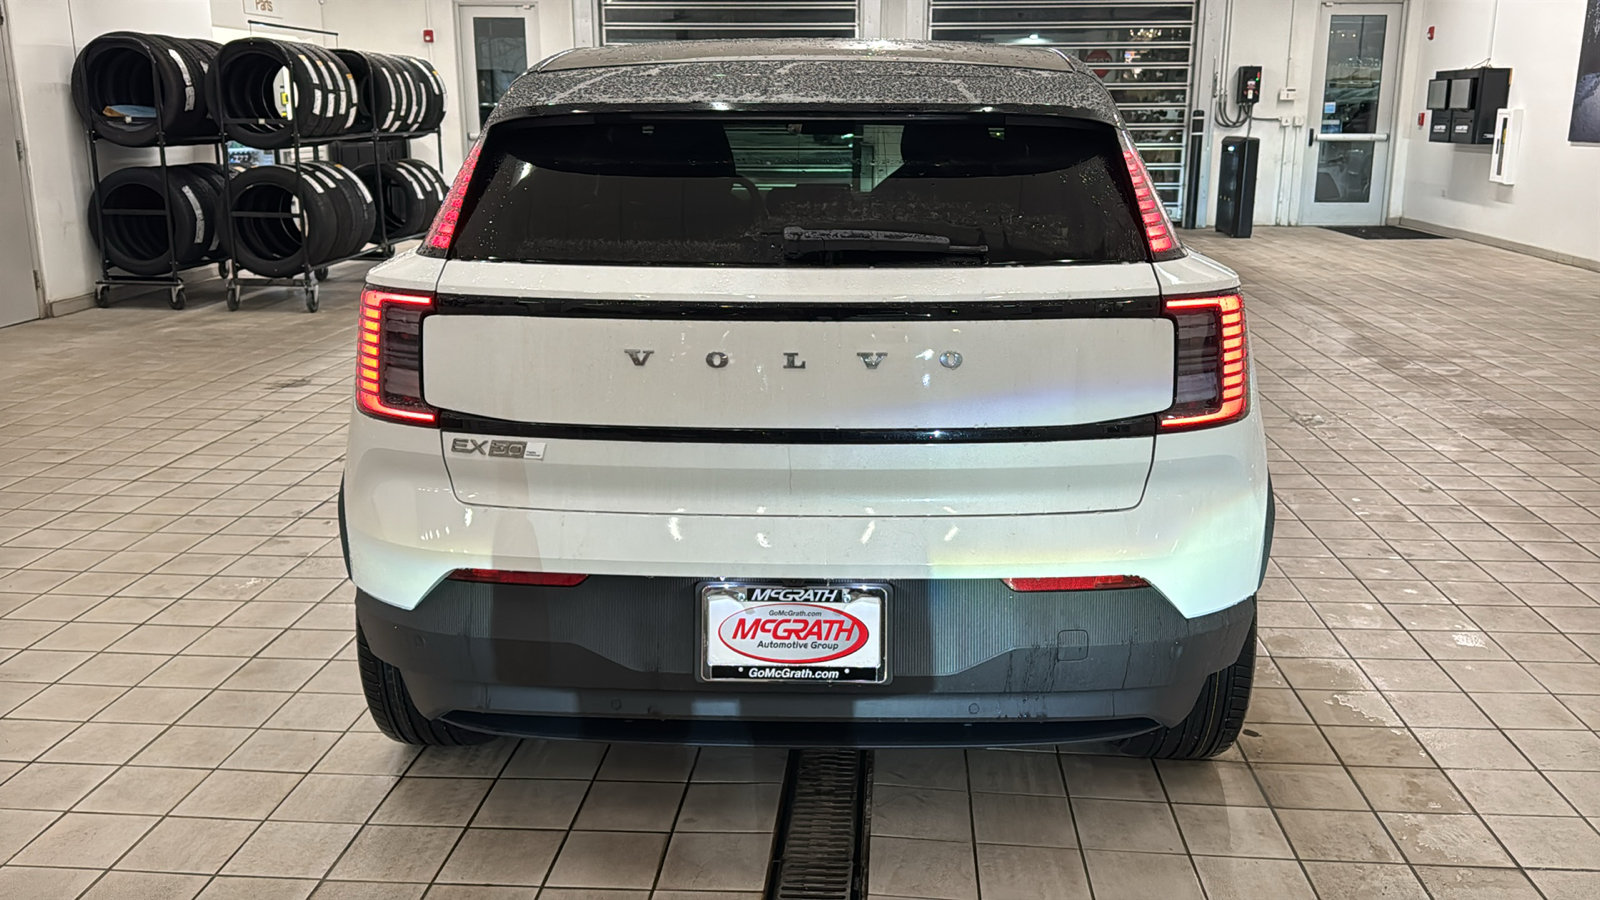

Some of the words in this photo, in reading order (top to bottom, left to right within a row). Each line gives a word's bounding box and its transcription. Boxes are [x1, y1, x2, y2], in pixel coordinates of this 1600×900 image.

[624, 349, 963, 370] VOLVO
[451, 438, 527, 459] EX30
[768, 609, 822, 618] GoMcGrath.com
[757, 640, 808, 649] Automotive
[810, 641, 839, 651] Group
[748, 668, 840, 679] GoMcGrath.com
